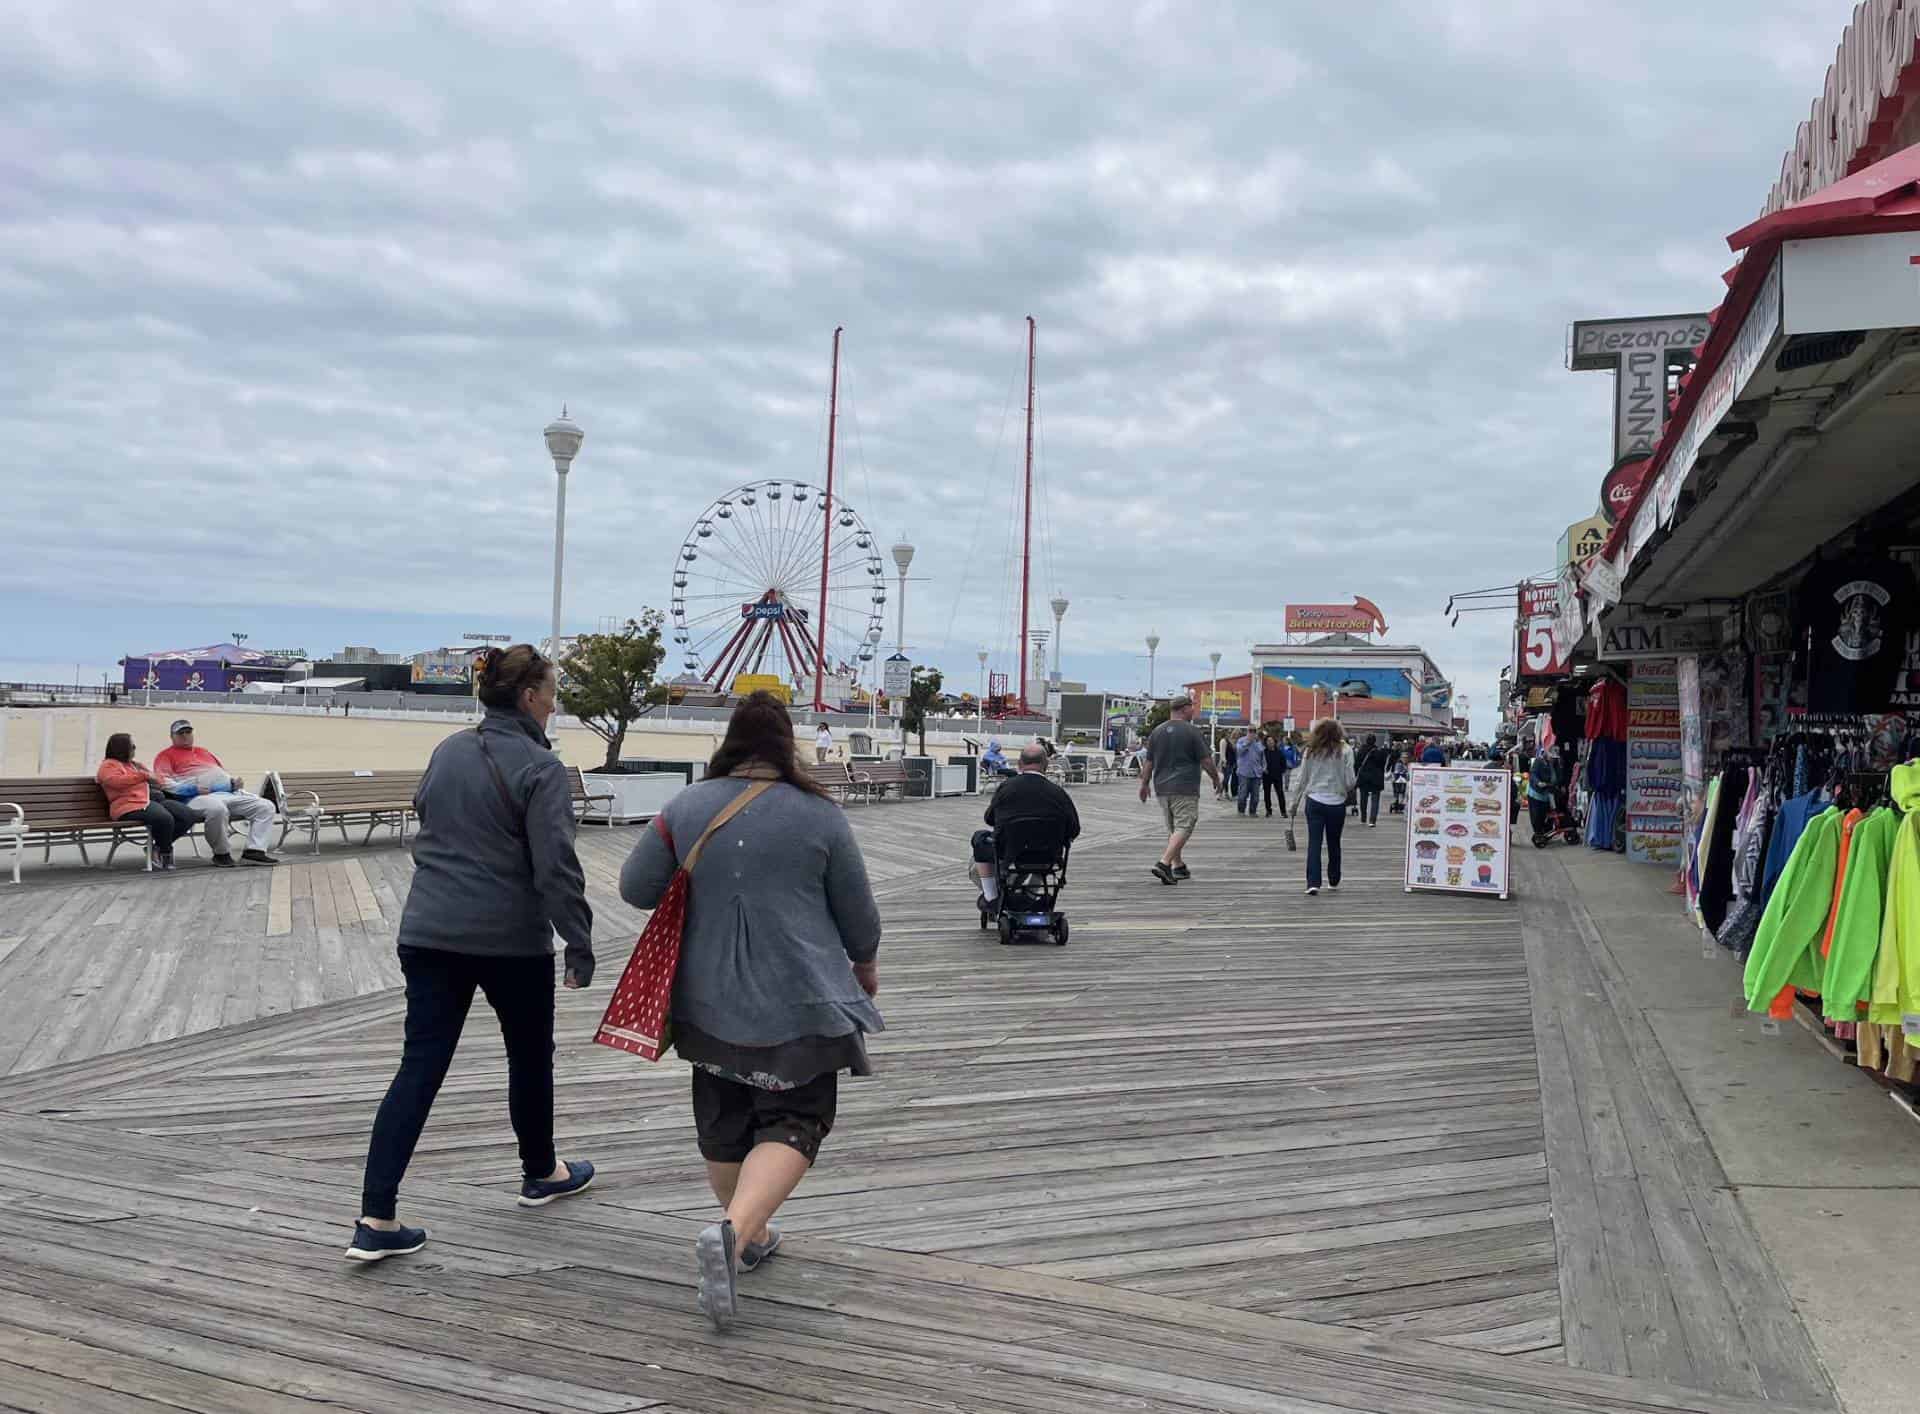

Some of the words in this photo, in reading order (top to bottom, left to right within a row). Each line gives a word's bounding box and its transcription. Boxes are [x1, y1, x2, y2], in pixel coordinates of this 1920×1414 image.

[755, 606, 781, 616] pepsi
[1604, 625, 1664, 650] ATM
[1631, 711, 1664, 724] PIZZA
